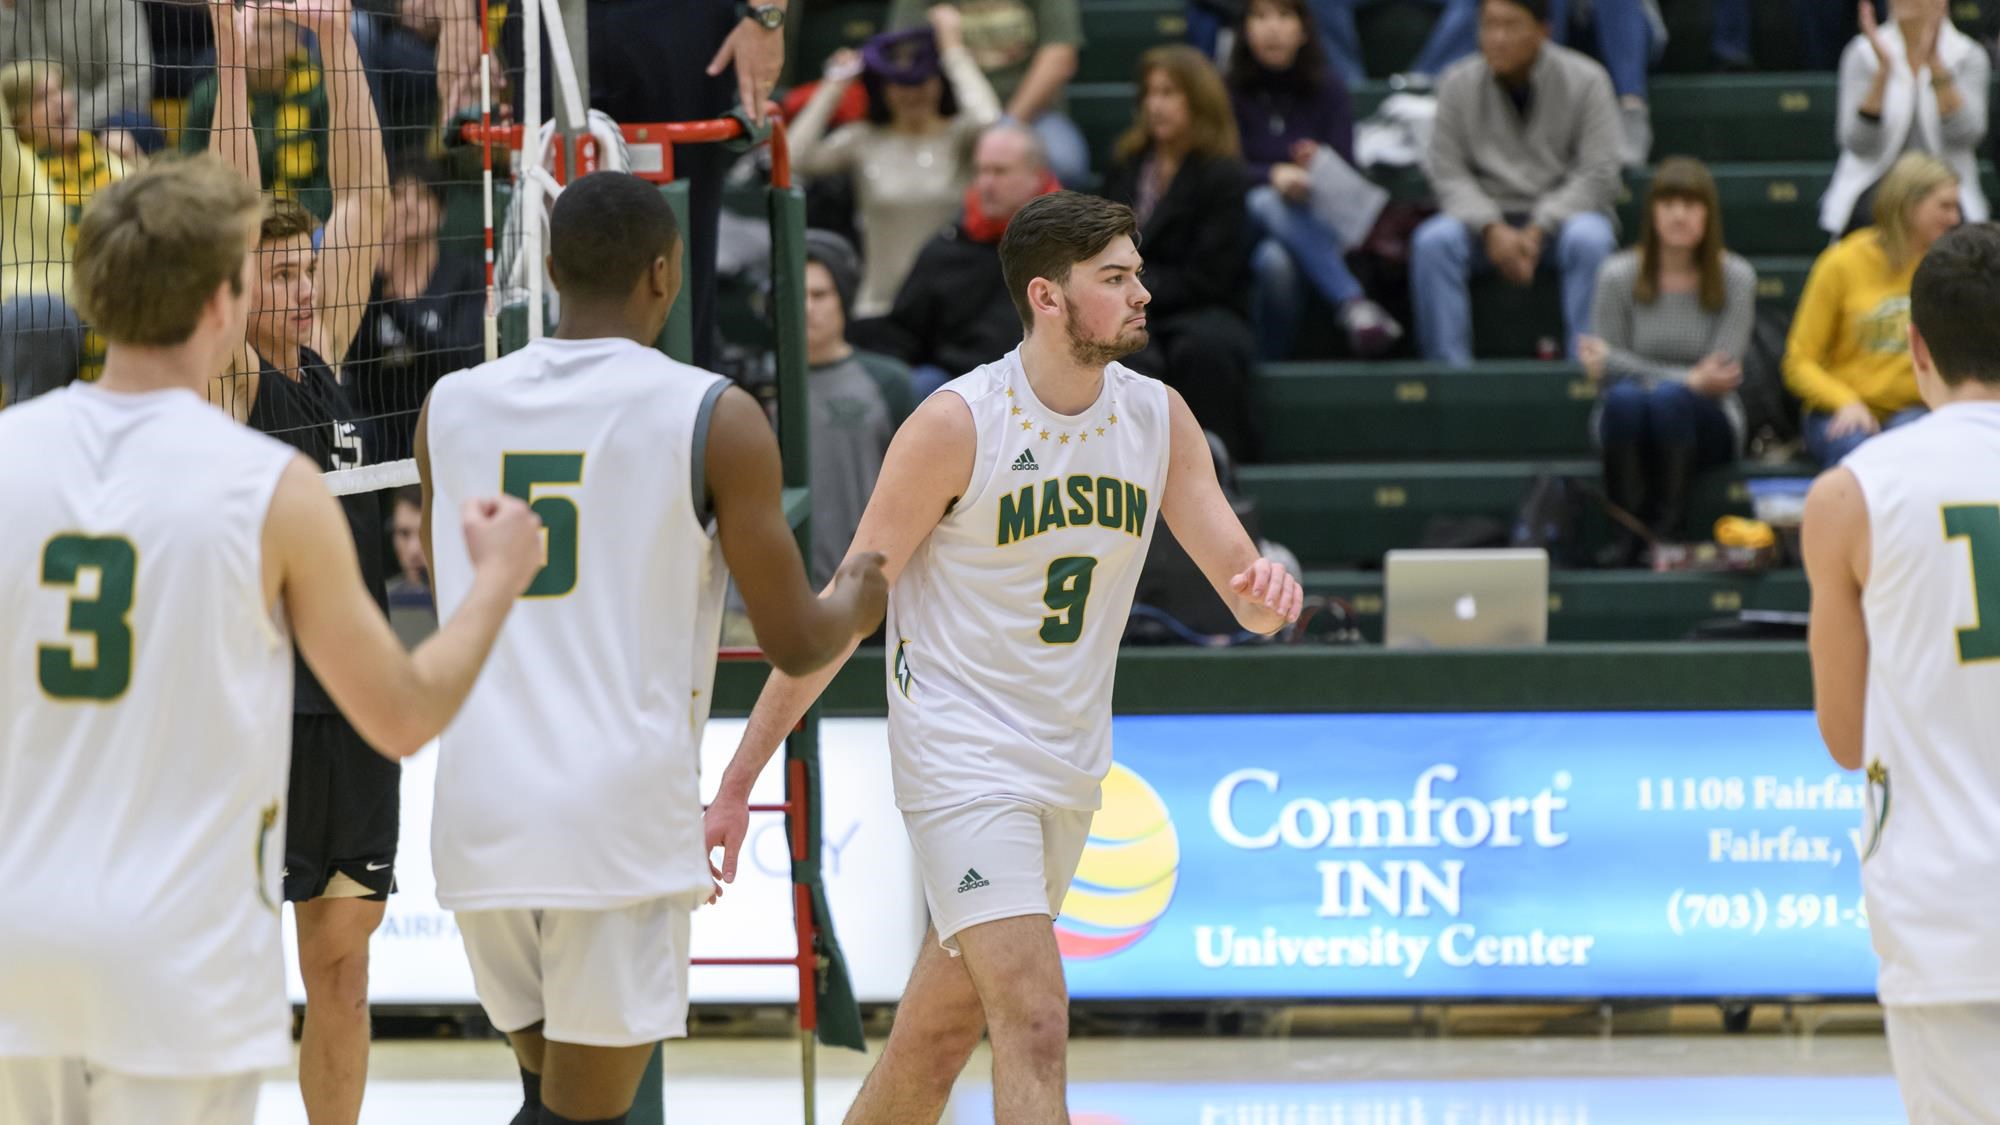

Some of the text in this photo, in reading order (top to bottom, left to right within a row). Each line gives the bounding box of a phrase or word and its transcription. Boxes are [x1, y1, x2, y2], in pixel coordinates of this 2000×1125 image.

[501, 451, 587, 600] 5
[996, 474, 1148, 546] MASON
[37, 532, 138, 702] 3
[1038, 555, 1099, 646] 9
[1208, 763, 1569, 849] Comfort
[1638, 777, 1745, 811] 11108
[1708, 826, 1842, 868] Fairfax,
[957, 879, 990, 894] adidas
[1317, 860, 1465, 918] INN
[1667, 888, 1768, 936] (703)
[1194, 922, 1596, 978] University Center
